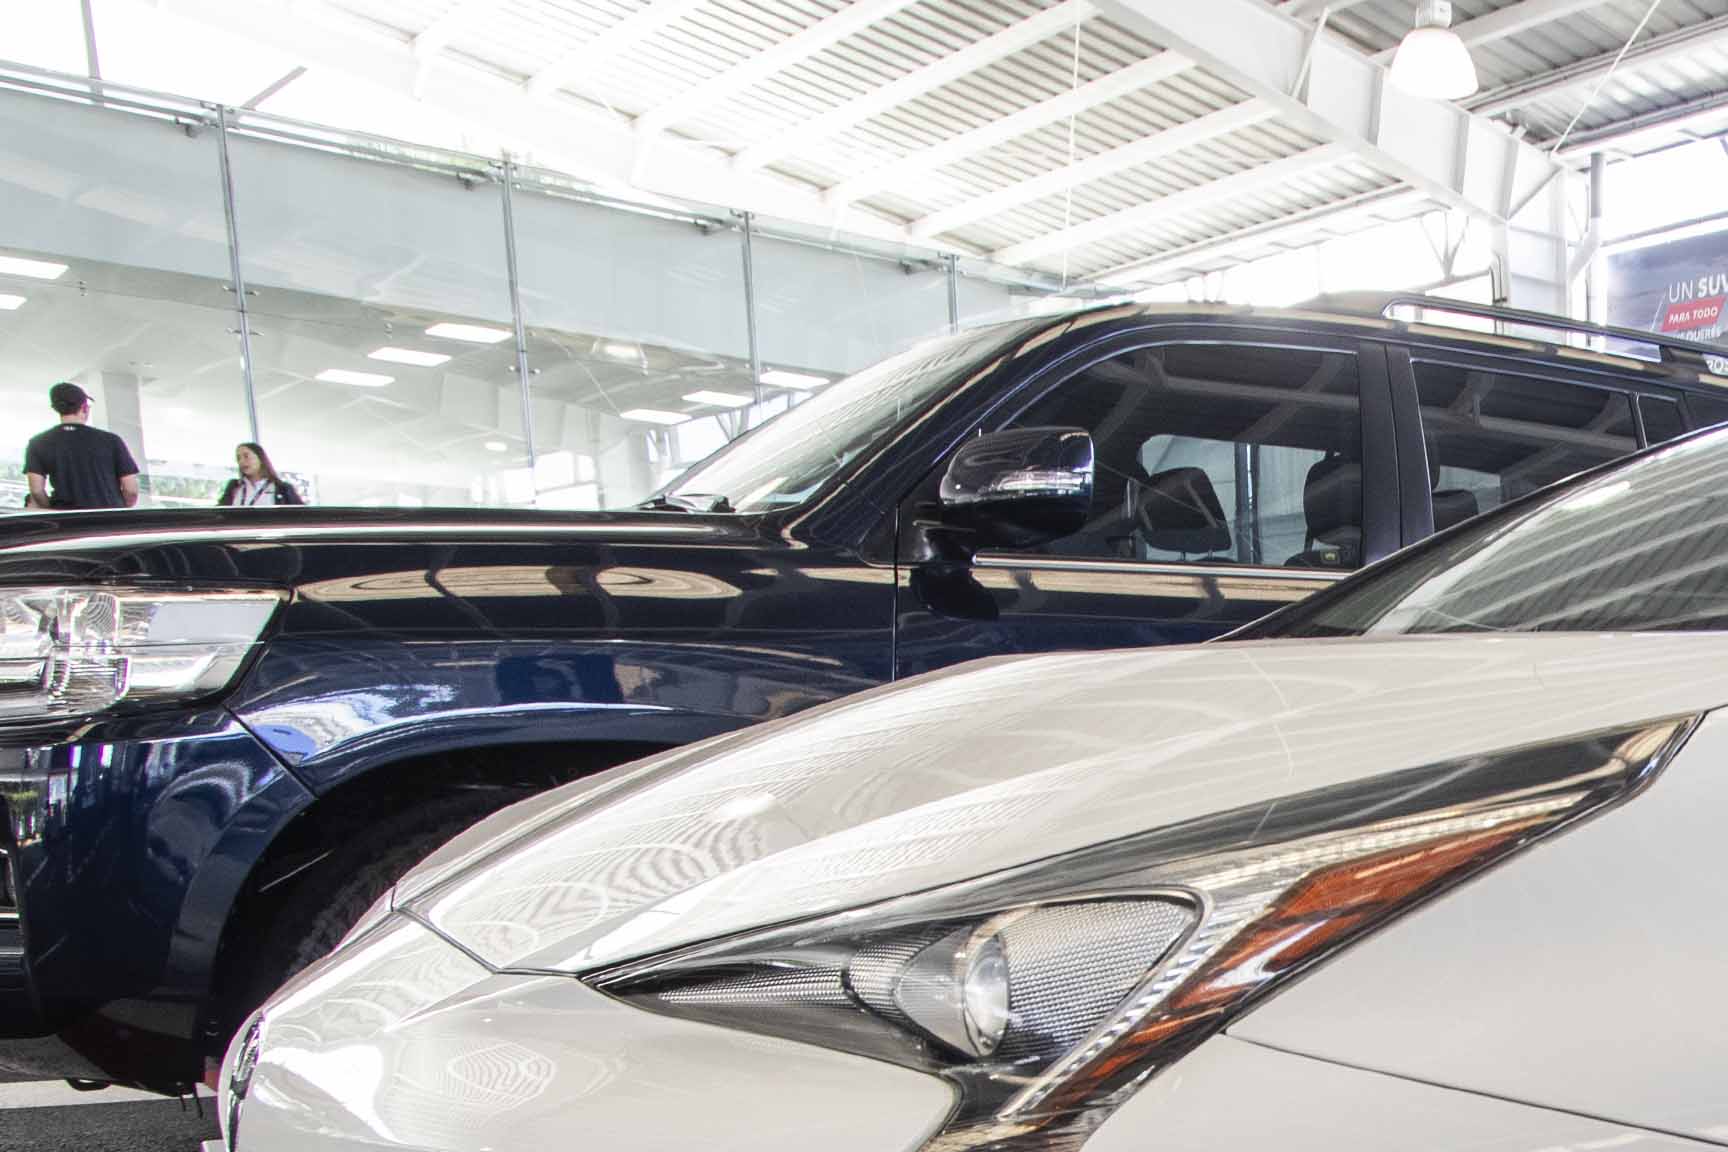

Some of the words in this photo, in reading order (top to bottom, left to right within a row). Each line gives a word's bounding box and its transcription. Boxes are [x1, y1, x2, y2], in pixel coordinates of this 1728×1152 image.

[1669, 280, 1694, 302] UN
[1668, 312, 1690, 325] PARA
[1692, 306, 1719, 320] TODO
